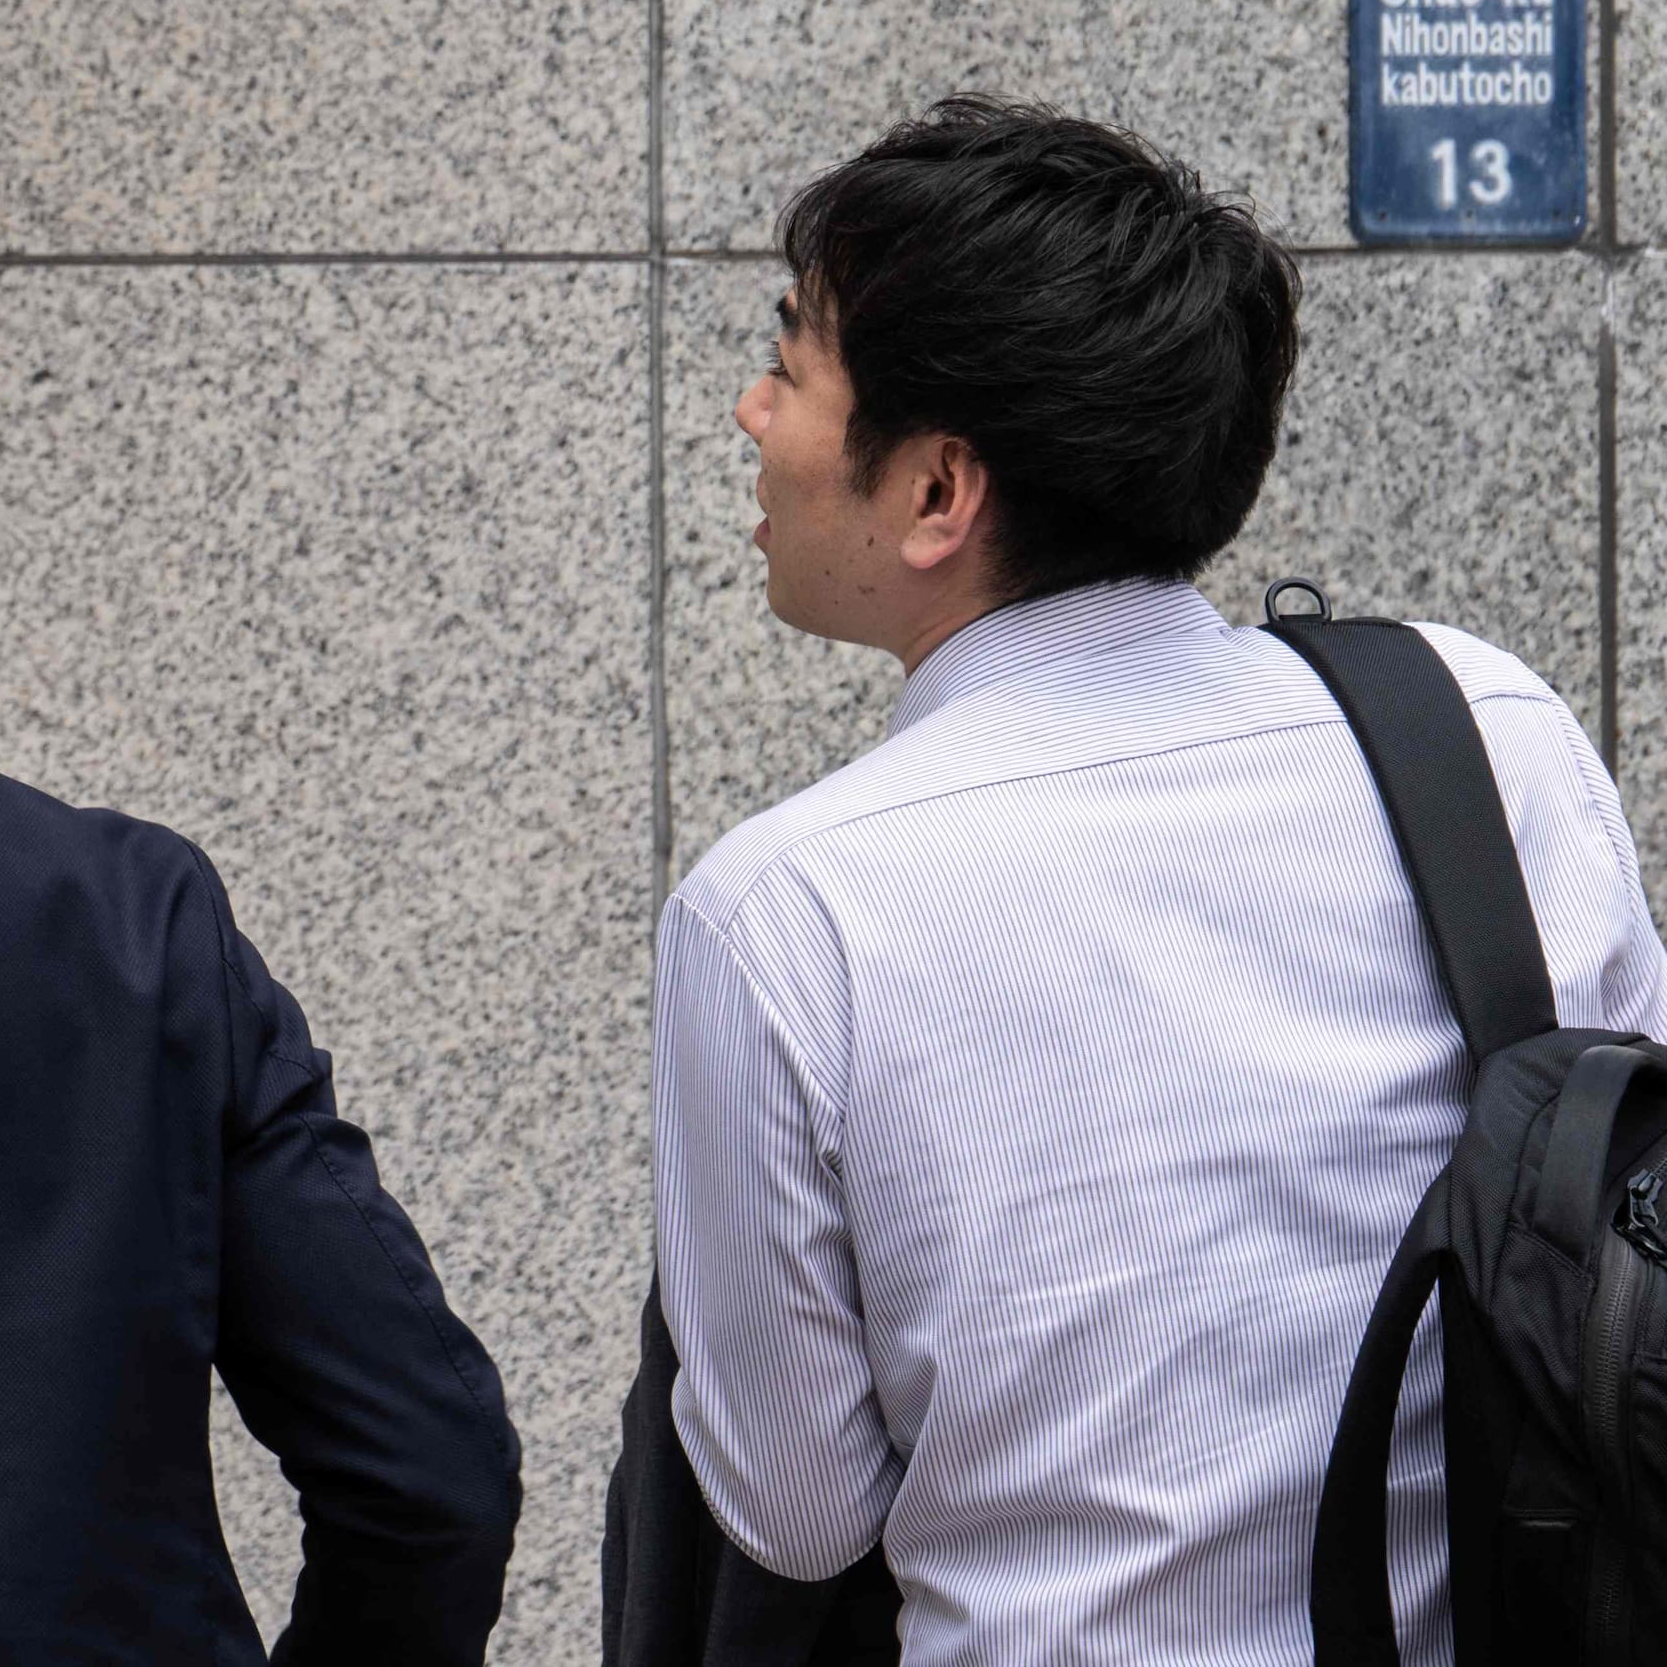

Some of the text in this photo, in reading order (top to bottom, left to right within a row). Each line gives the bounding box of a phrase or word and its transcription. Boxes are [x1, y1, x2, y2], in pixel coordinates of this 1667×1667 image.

[1381, 12, 1554, 57] Nihonbashi
[1381, 62, 1554, 107] kabutocho
[1431, 139, 1514, 207] 13
